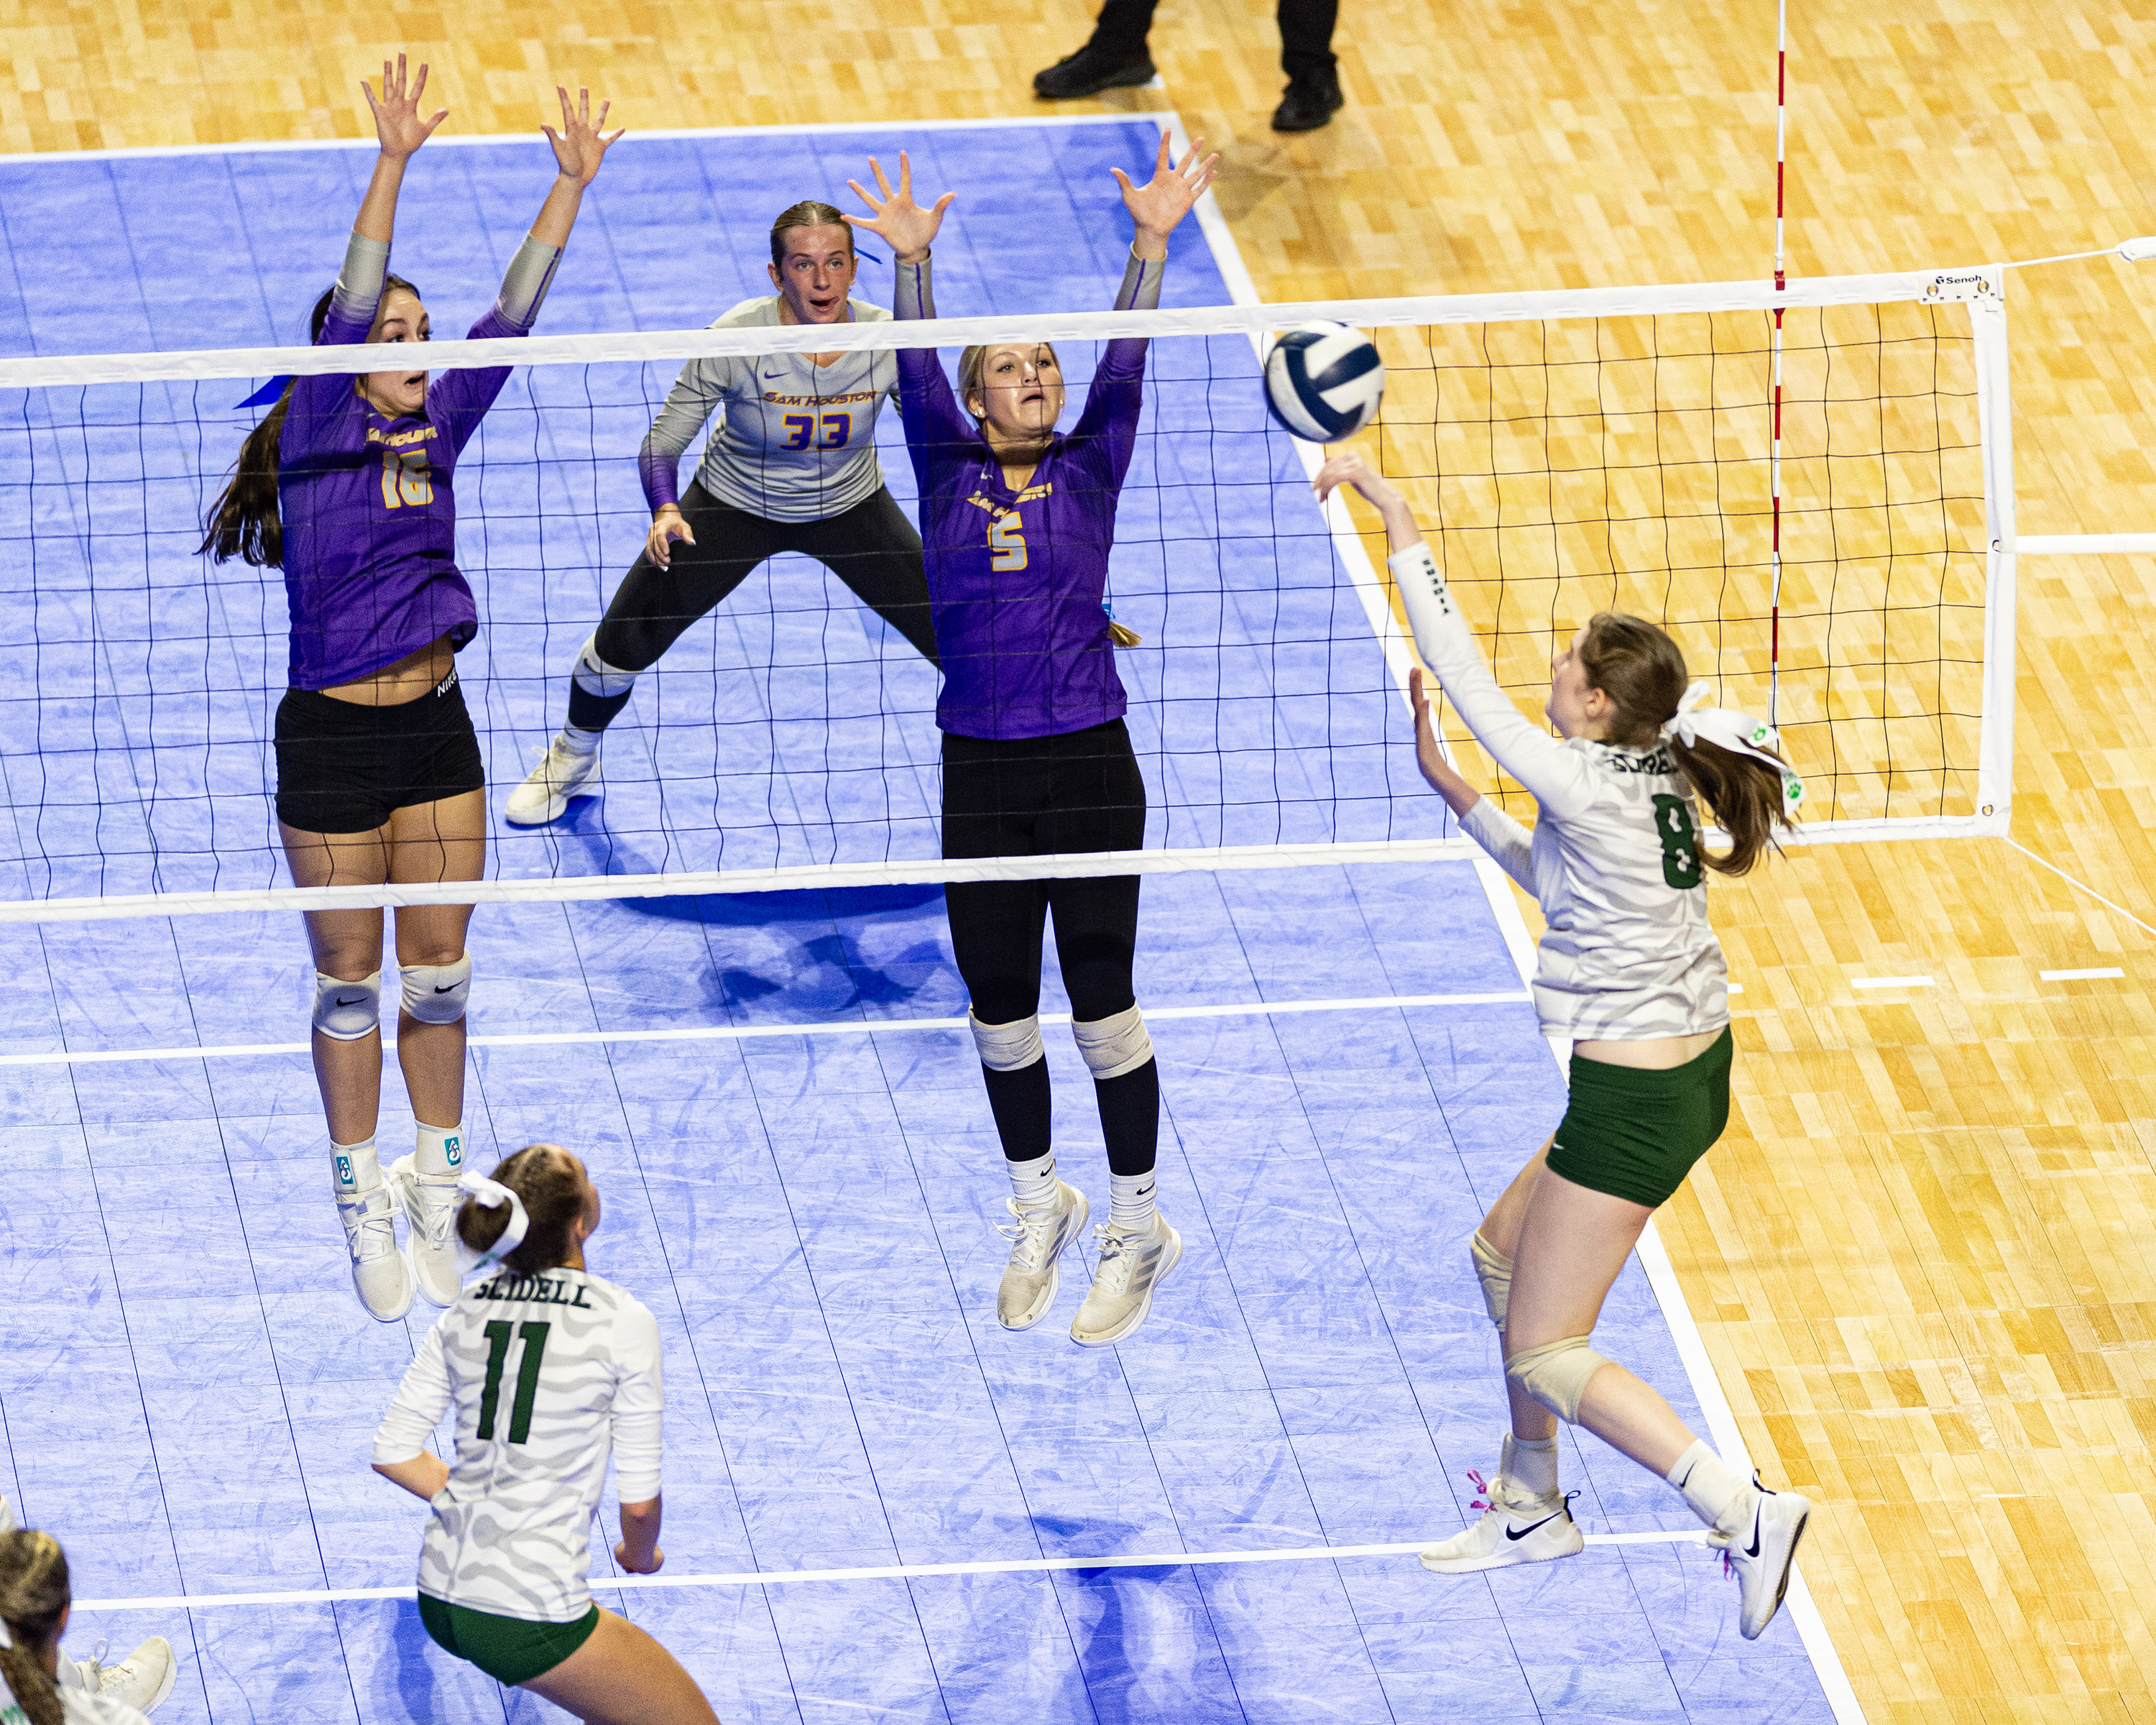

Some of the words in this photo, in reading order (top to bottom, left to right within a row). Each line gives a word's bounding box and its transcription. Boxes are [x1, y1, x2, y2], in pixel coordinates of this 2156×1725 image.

[1946, 275, 1982, 285] Senoh
[762, 390, 802, 407] SAM
[804, 389, 878, 407] HOUSTON
[778, 411, 853, 453] 33
[382, 448, 434, 509] 16
[987, 511, 1028, 572] 5
[437, 666, 457, 697] NIKE
[1651, 793, 1702, 889] 8
[476, 1320, 551, 1445] 11
